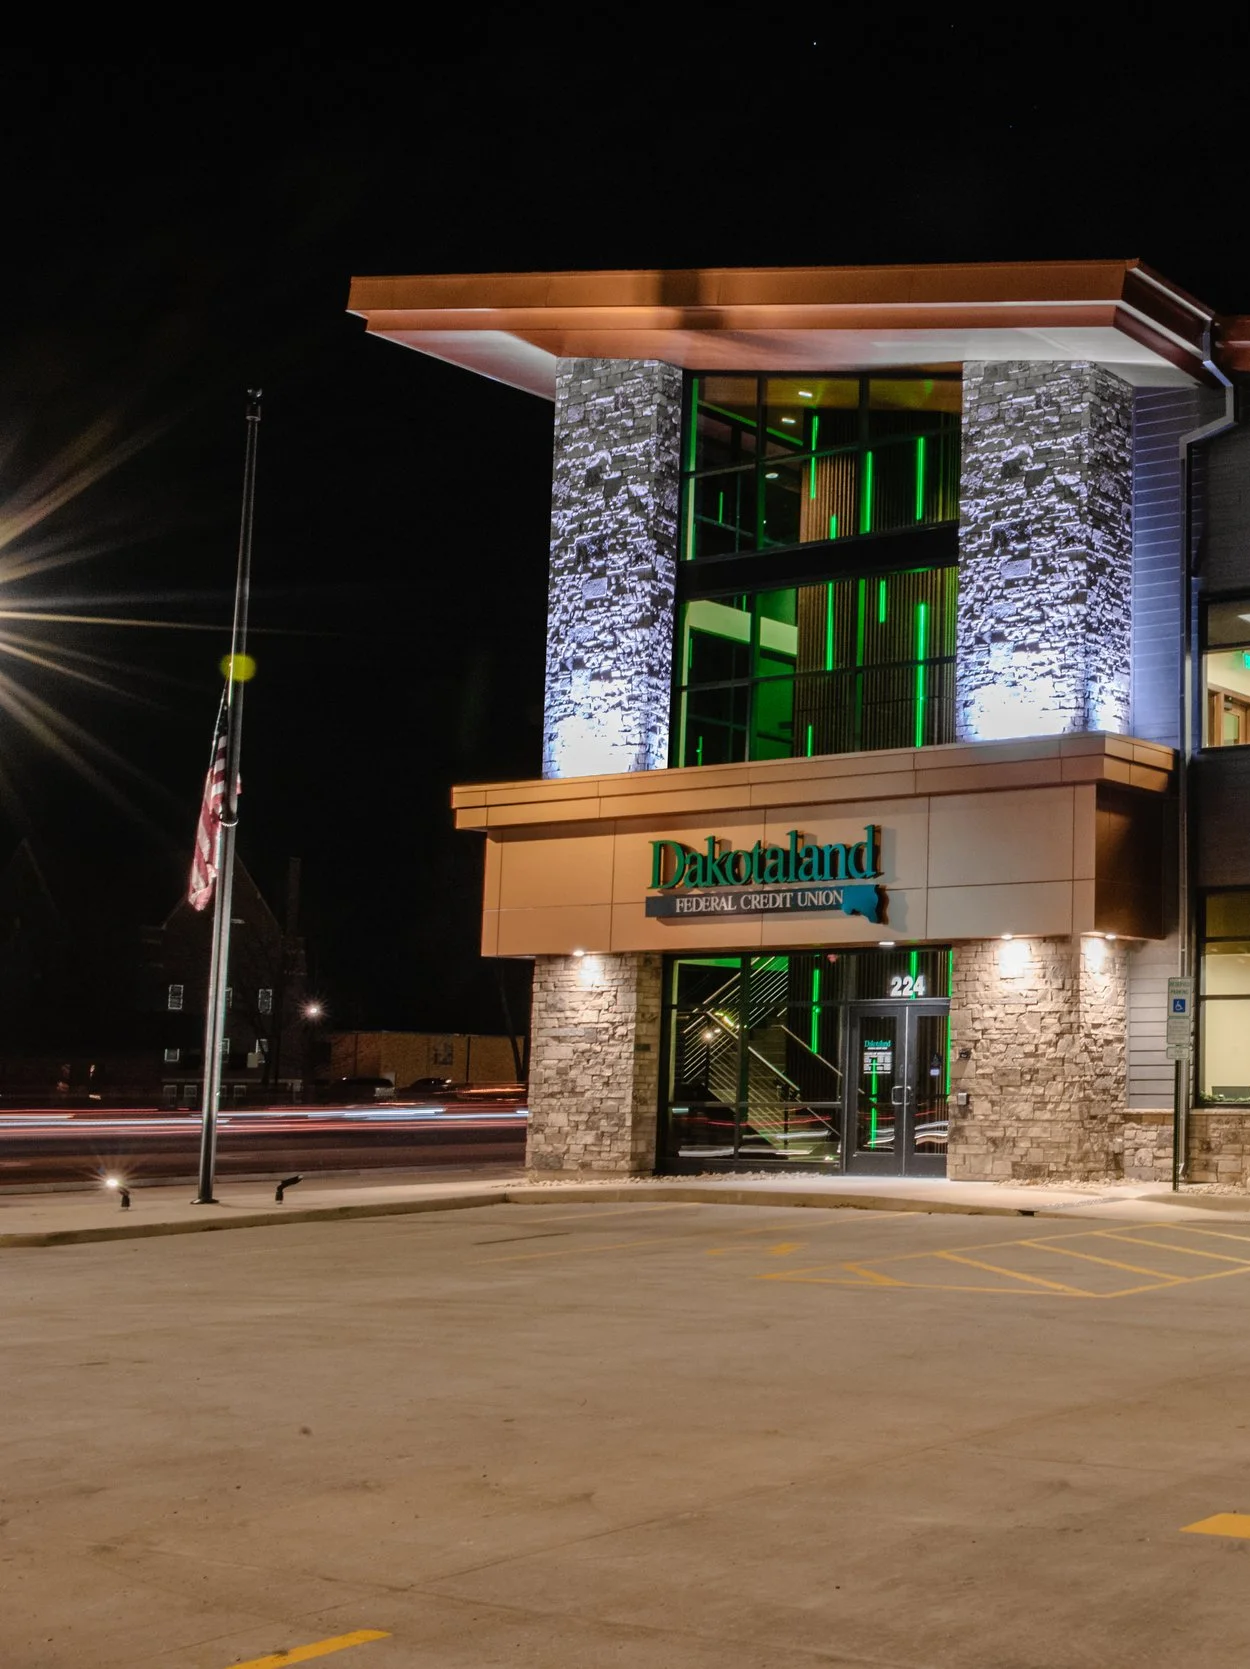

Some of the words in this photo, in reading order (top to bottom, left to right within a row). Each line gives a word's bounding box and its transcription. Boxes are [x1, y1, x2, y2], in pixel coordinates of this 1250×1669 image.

[647, 824, 880, 889] Dakotaland
[676, 894, 736, 913] FEDERAL
[740, 892, 793, 910] CREDIT
[797, 889, 844, 907] UNION
[890, 975, 926, 997] 224
